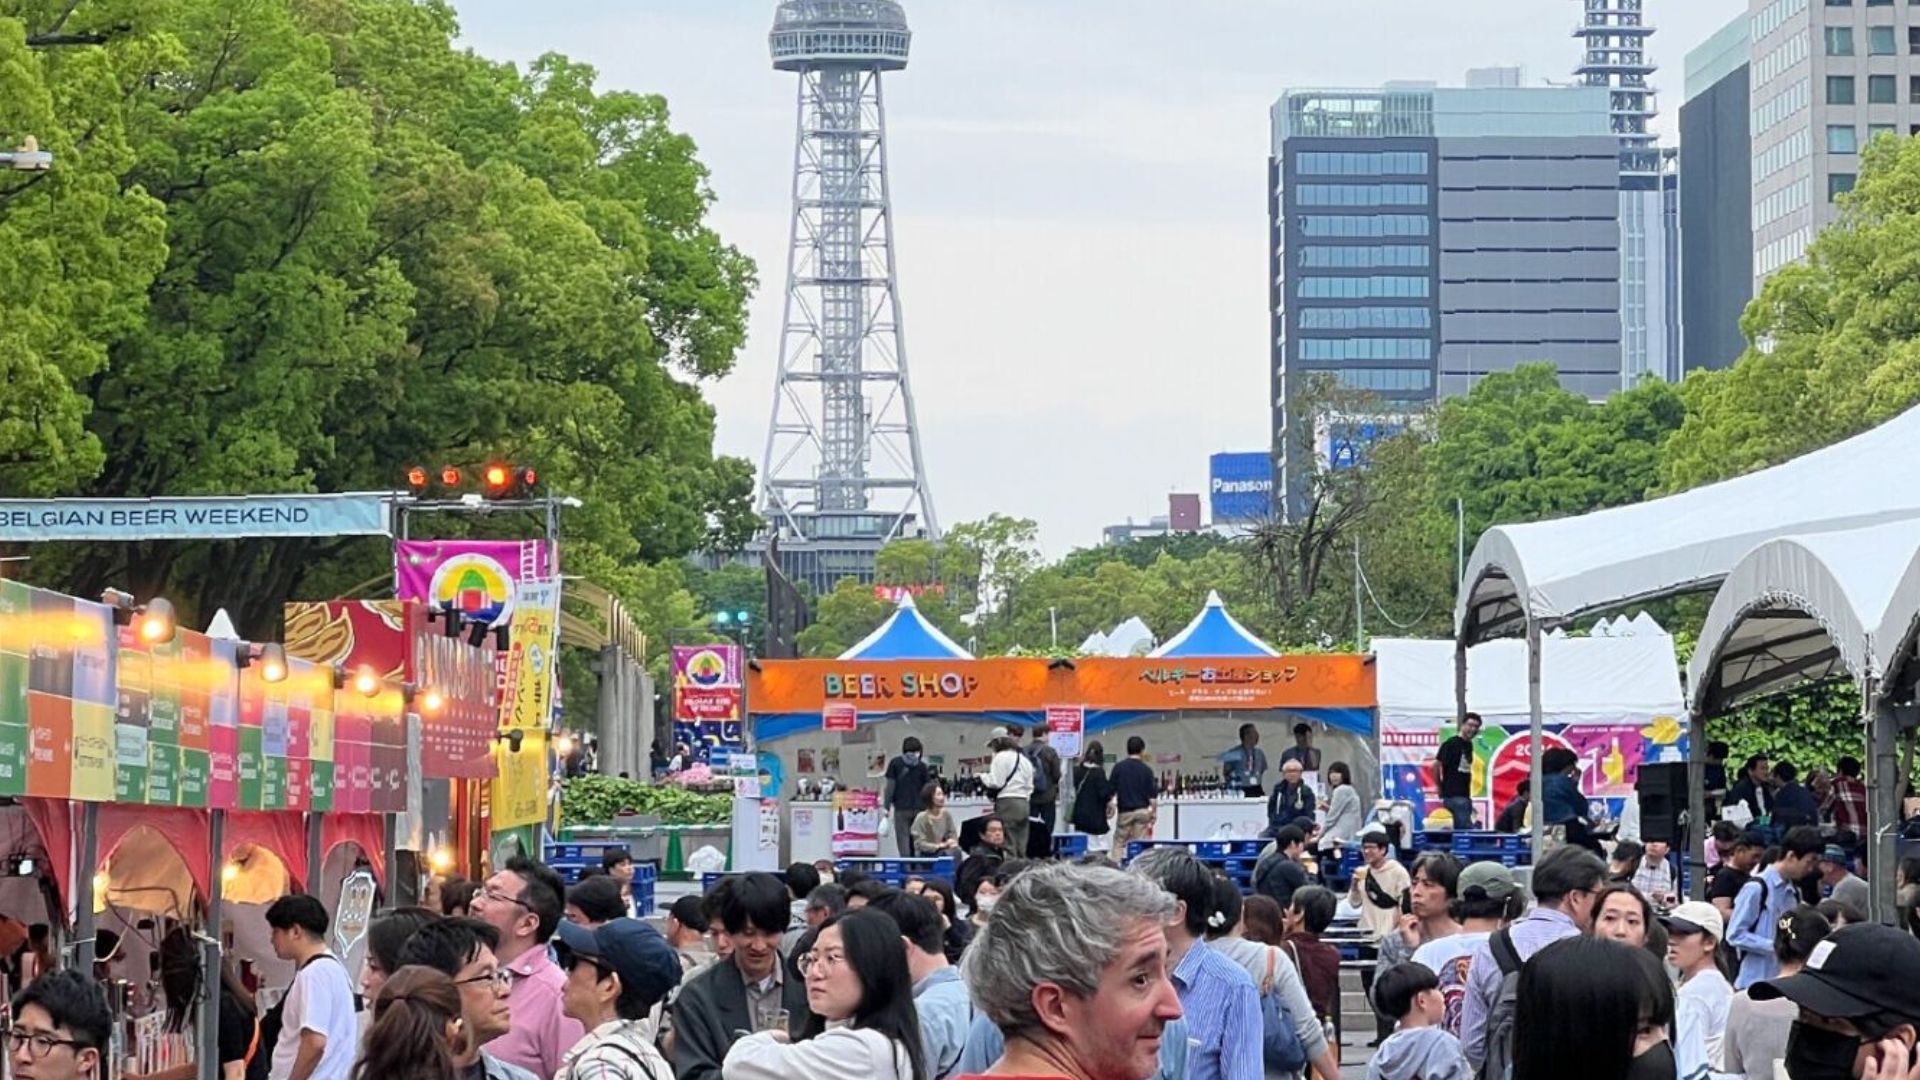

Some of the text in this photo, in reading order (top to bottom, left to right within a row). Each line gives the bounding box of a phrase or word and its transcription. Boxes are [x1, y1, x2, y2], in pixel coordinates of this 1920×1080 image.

[0, 507, 309, 527] BELGIAN BEER WEEKEND
[825, 672, 978, 698] BEER SHOP
